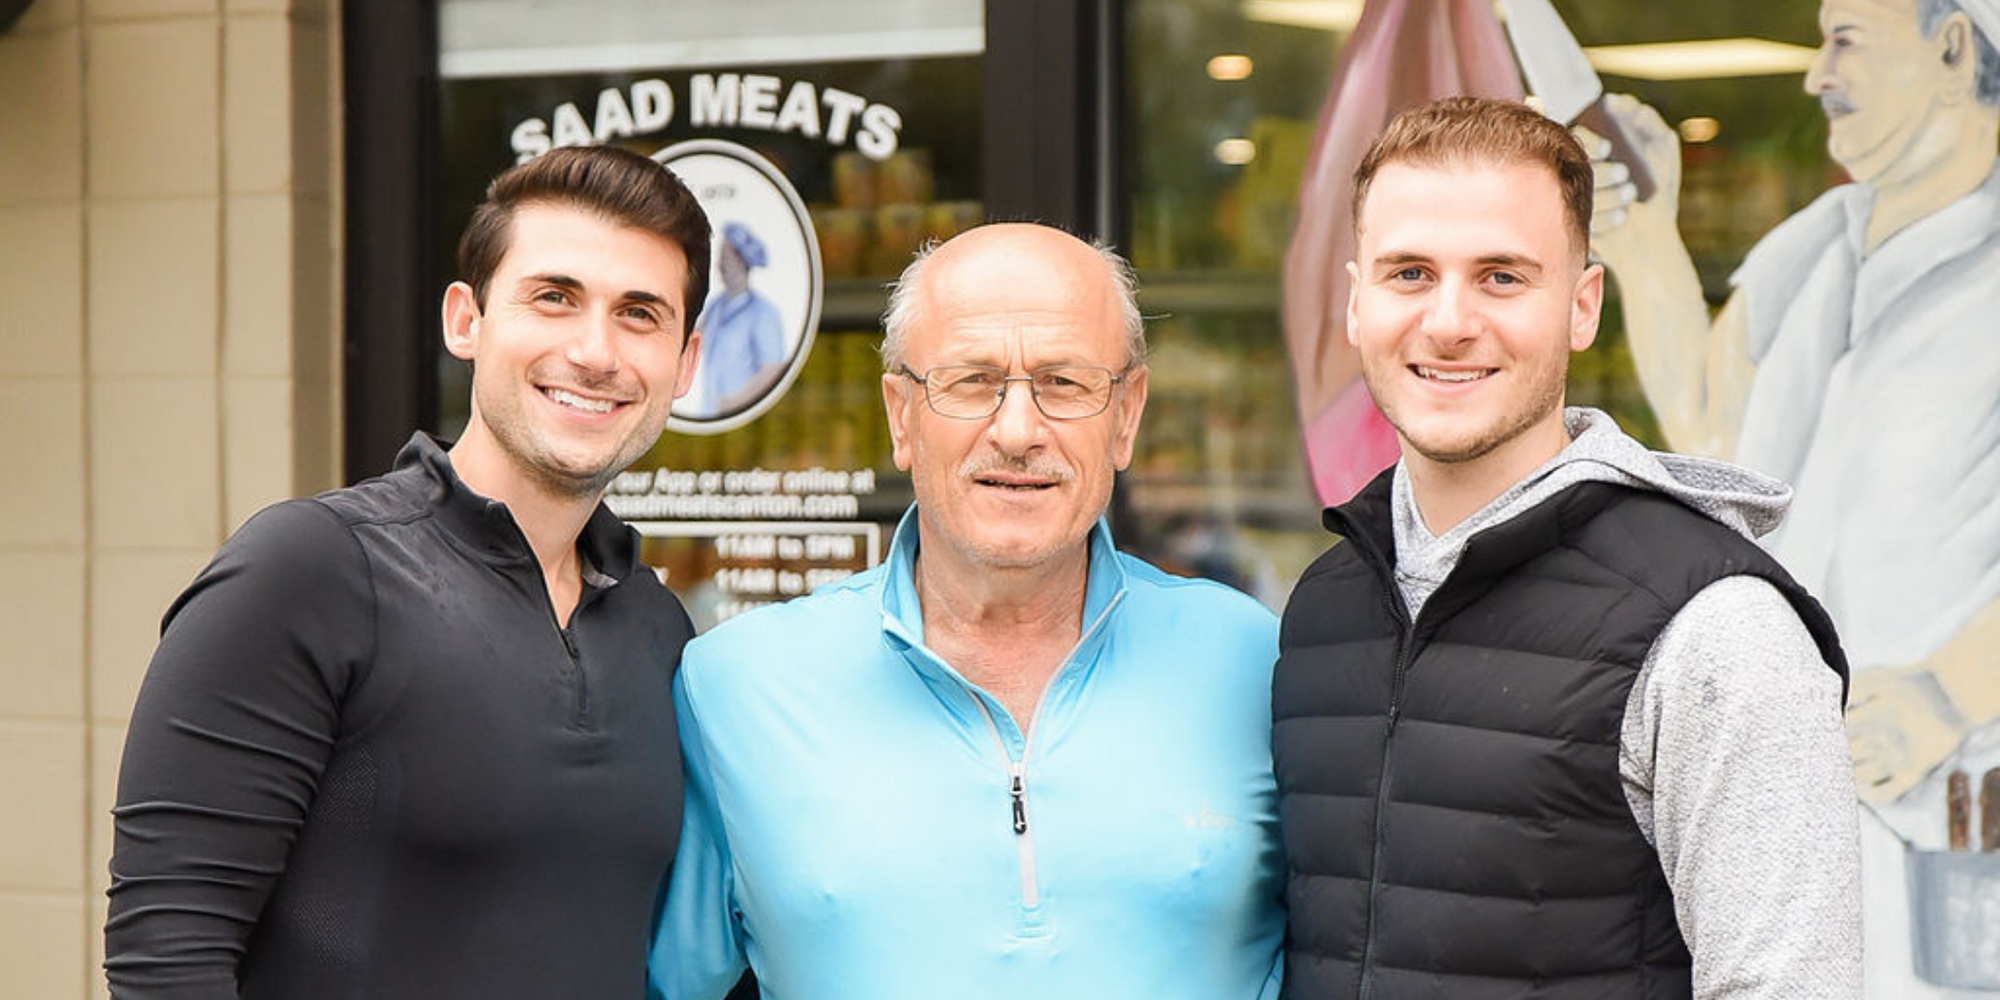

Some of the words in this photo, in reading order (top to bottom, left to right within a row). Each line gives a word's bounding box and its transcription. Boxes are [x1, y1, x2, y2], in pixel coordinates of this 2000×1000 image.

[510, 78, 675, 166] SAAD
[689, 73, 902, 162] MEATS
[654, 467, 698, 498] App
[699, 471, 723, 494] or
[724, 468, 780, 494] order
[783, 467, 850, 494] online
[851, 467, 875, 494] at
[778, 536, 804, 560] to
[778, 568, 804, 595] to
